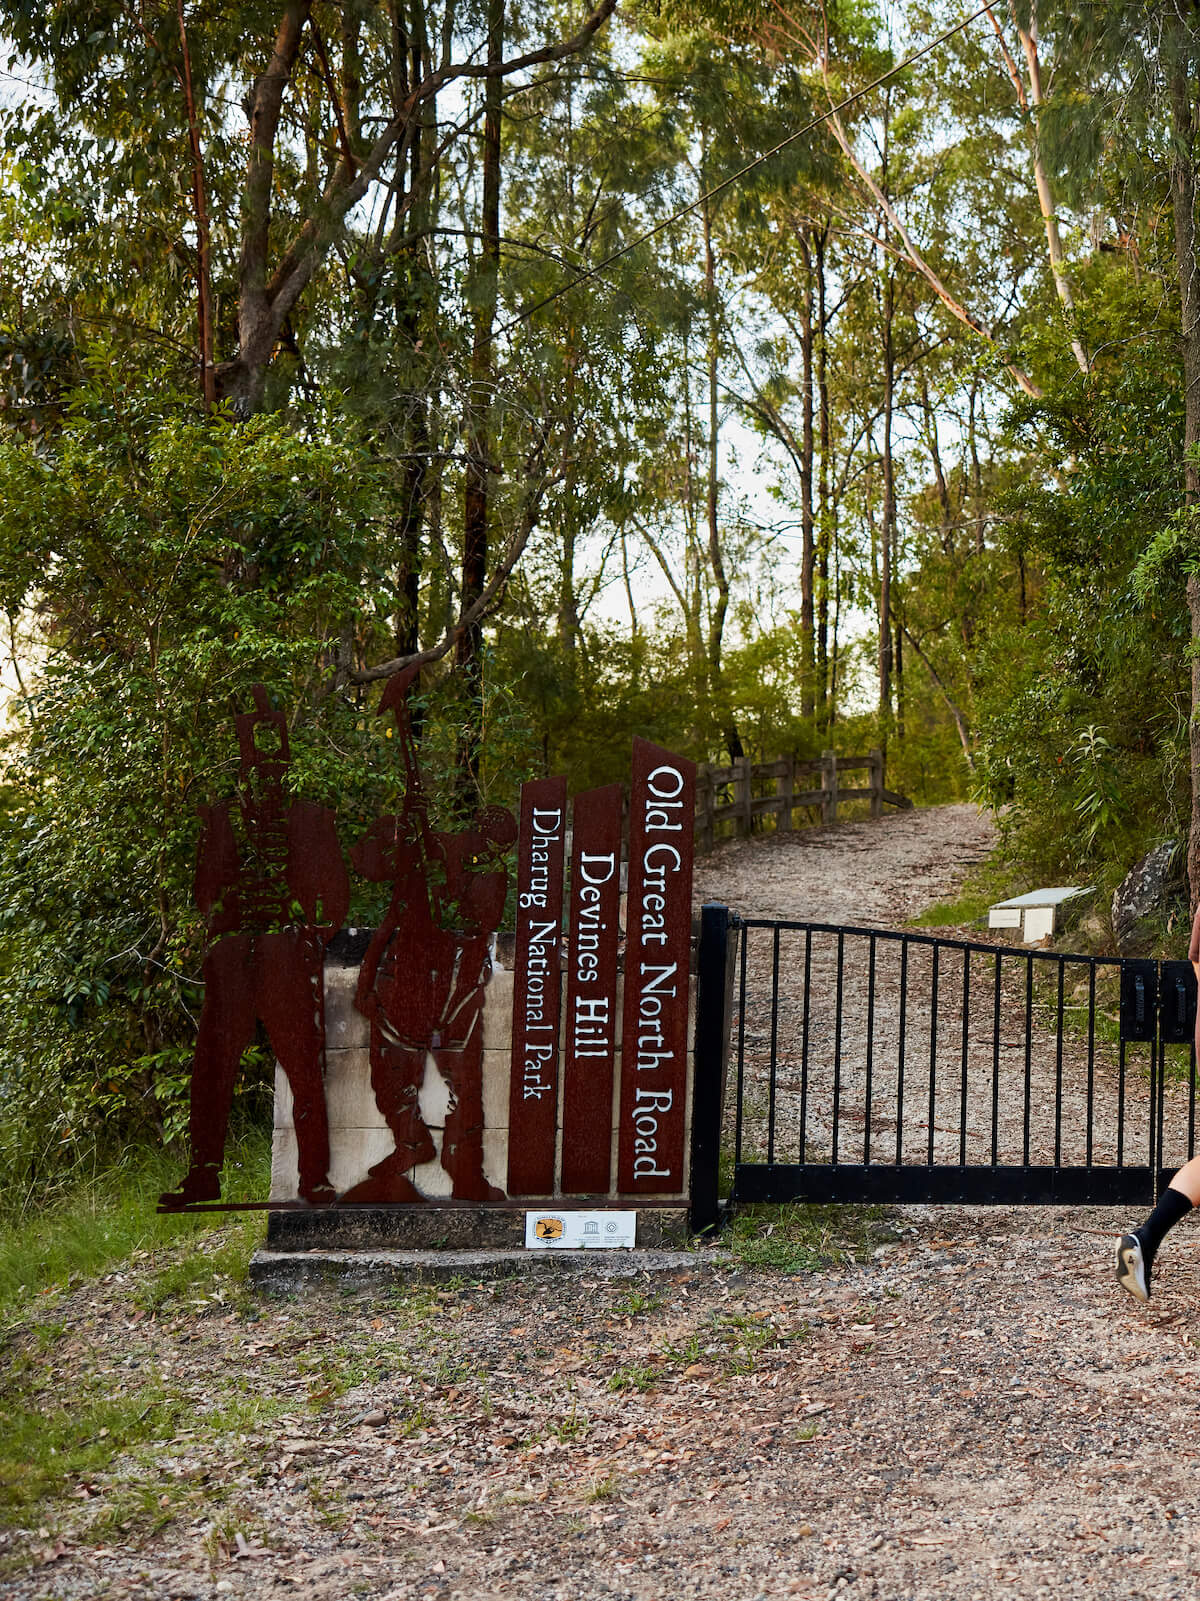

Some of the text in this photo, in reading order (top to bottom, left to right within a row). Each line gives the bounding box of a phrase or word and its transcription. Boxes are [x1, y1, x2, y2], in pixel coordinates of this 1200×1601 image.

[519, 807, 562, 1100] Dharug National Park
[574, 851, 615, 1059] Devines Hill
[631, 765, 684, 1180] Old Great North Road
